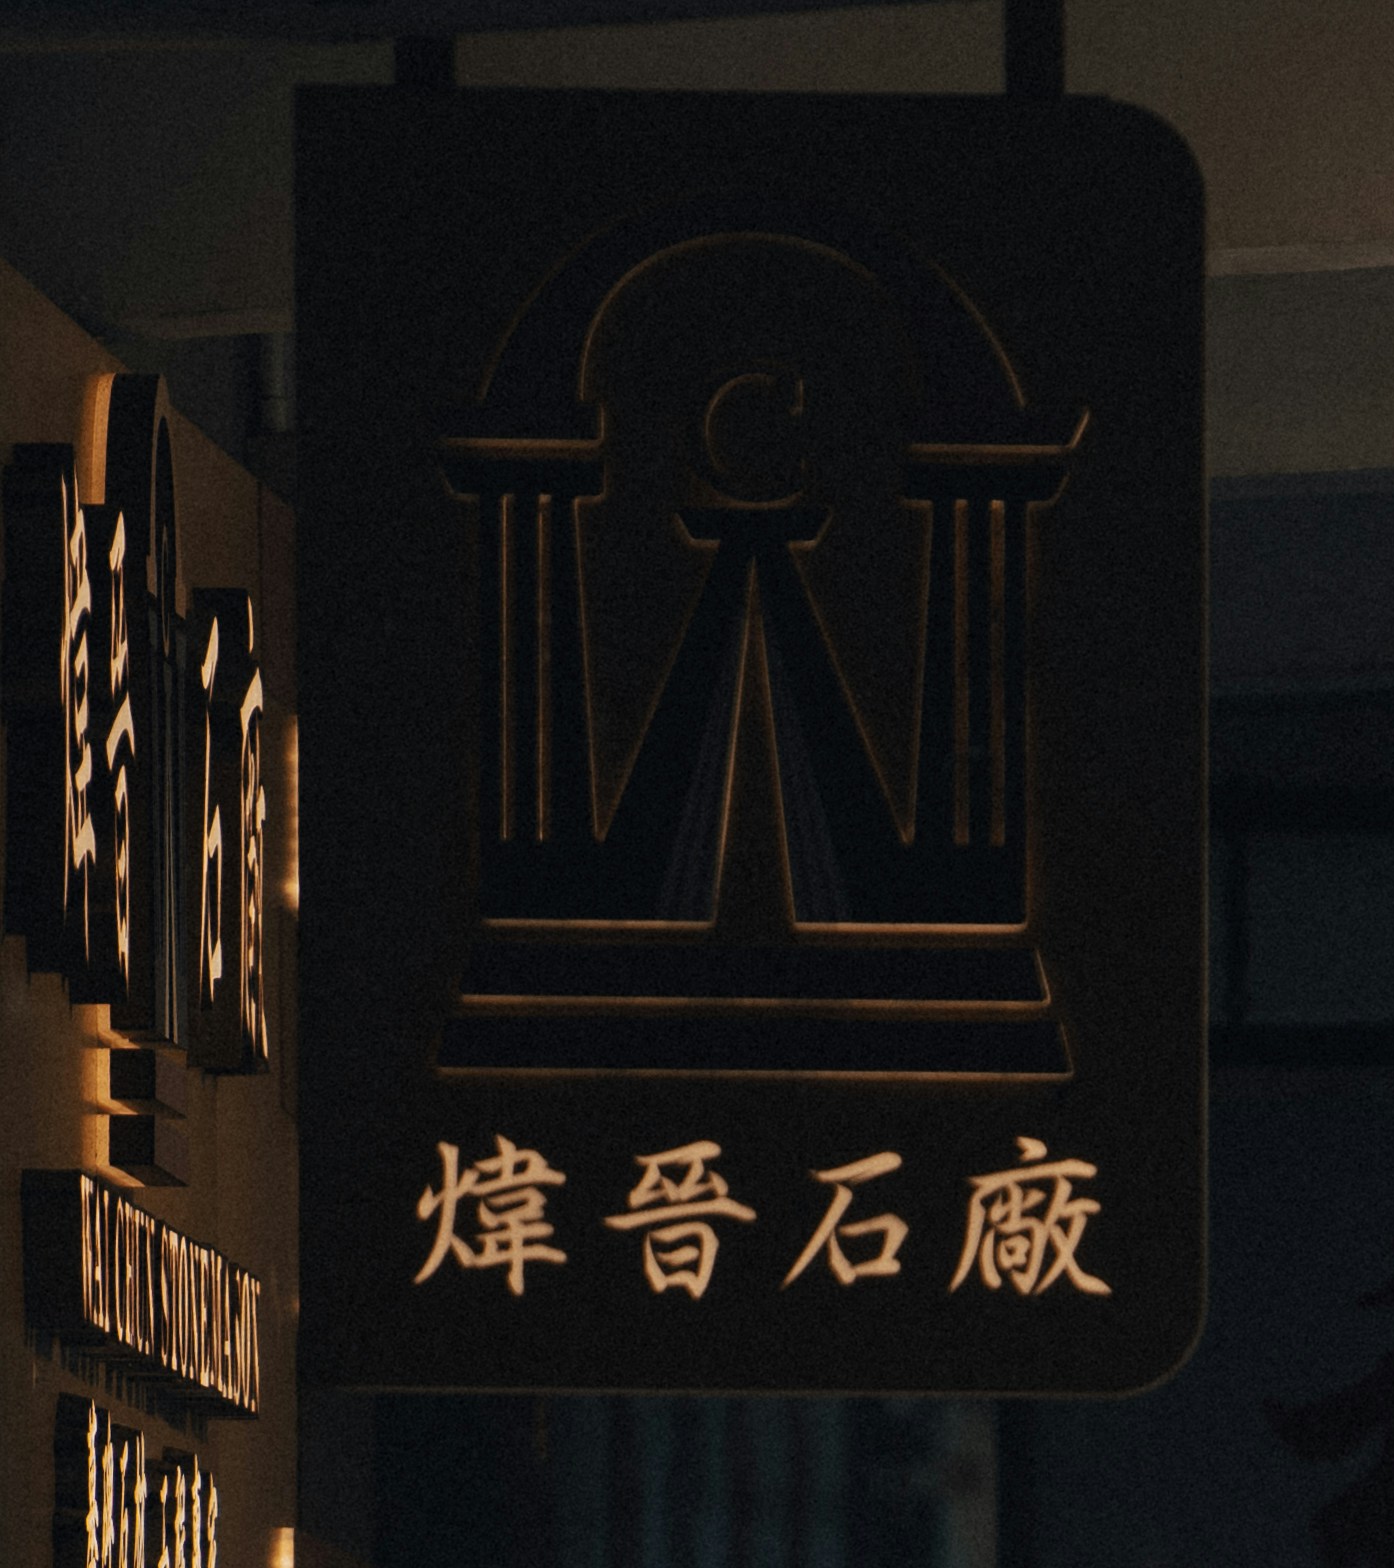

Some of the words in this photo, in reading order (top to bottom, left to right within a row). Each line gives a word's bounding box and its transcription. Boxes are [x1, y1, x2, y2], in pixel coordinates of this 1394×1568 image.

[80, 1173, 111, 1333] WAI
[114, 1196, 156, 1356] CHUN
[160, 1224, 261, 1413] STONEMASON
[413, 1135, 1112, 1296] 煒晉石廠
